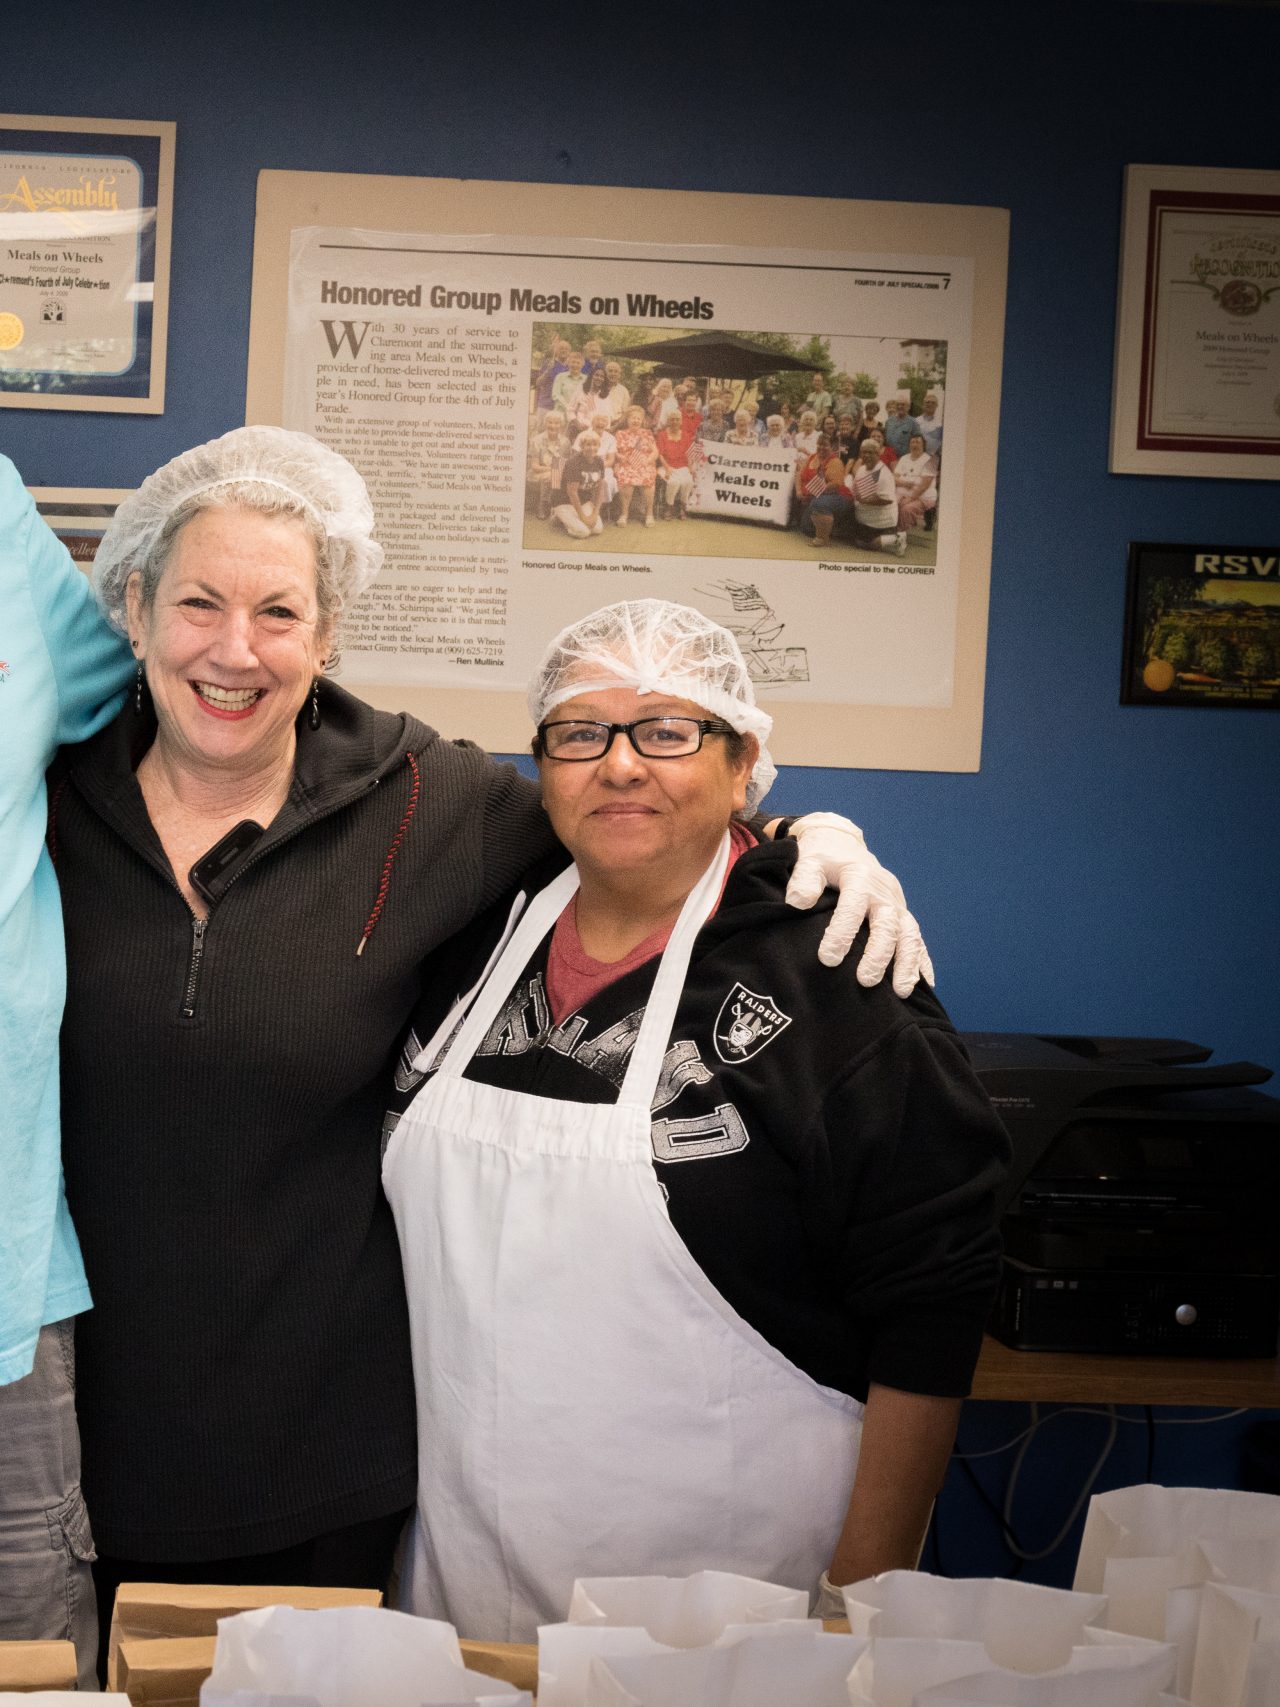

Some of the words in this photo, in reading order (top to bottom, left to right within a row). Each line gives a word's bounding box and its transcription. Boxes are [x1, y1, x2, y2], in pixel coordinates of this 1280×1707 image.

[8, 249, 41, 261] Meals
[63, 252, 103, 263] Wheels
[29, 265, 58, 273] Honored
[60, 265, 80, 275] Group
[36, 276, 53, 288] Fourth
[55, 276, 60, 287] of
[62, 276, 73, 290] July
[942, 278, 950, 290] 7
[321, 280, 421, 308] Honored
[431, 285, 501, 316] Group
[510, 288, 581, 315] Meals
[590, 297, 619, 316] on
[627, 293, 713, 321] Wheels
[392, 323, 405, 334] 30
[412, 327, 439, 338] years
[447, 325, 458, 336] of
[465, 329, 501, 338] service
[509, 330, 519, 338] to
[1196, 330, 1225, 342] Meals
[1228, 331, 1240, 342] on
[1242, 332, 1279, 343] Wheels
[371, 336, 423, 349] Claremont
[428, 338, 446, 349] and
[450, 339, 465, 350] the
[471, 340, 518, 352] surround-
[370, 350, 386, 363] ing
[391, 353, 411, 362] area
[416, 352, 446, 363] Meals
[450, 355, 462, 364] on
[468, 354, 507, 366] Wheels,
[317, 362, 358, 376] provider
[361, 363, 372, 374] of
[374, 364, 450, 377] home-delivered
[452, 367, 481, 378] meals
[483, 370, 493, 378] to
[495, 371, 516, 382] peo-
[316, 375, 332, 388] ple
[338, 376, 347, 387] in
[353, 377, 379, 388] need,
[385, 378, 402, 389] has
[408, 379, 431, 390] been
[437, 380, 476, 392] selected
[483, 384, 492, 392] as
[499, 383, 516, 393] this
[316, 388, 345, 403] year's
[348, 390, 391, 402] Honored
[394, 392, 426, 406] Group
[429, 393, 443, 404] for
[446, 394, 461, 405] the
[464, 394, 479, 405] 4th
[482, 395, 493, 406] of
[495, 396, 516, 409] July
[316, 402, 352, 414] Parade.
[324, 415, 343, 424] With
[358, 418, 394, 426] extensive
[397, 420, 419, 430] group
[478, 421, 501, 431] Meals
[315, 425, 343, 434] Wheels
[381, 428, 410, 439] provide
[412, 428, 472, 440] home-delivered
[474, 433, 505, 441] services
[427, 450, 467, 460] Volunteers
[708, 454, 790, 473] Claremont
[714, 472, 756, 487] Meals
[760, 480, 779, 490] on
[716, 490, 772, 508] Wheels
[417, 502, 450, 511] residents
[463, 503, 477, 512] San
[480, 504, 511, 513] Antonio
[400, 511, 436, 523] packaged
[460, 513, 496, 523] delivered
[428, 522, 467, 532] Deliveries
[376, 530, 400, 541] Friday
[448, 533, 479, 544] holidays
[522, 561, 555, 569] Honored
[558, 562, 582, 572] Group
[585, 563, 607, 571] Meals
[622, 565, 652, 573] Wheels.
[819, 563, 841, 571] Photo
[844, 565, 871, 573] special
[883, 566, 895, 574] the
[898, 564, 935, 575] COURIER
[1195, 554, 1280, 576] RSV
[437, 635, 460, 644] Meals
[477, 637, 505, 646] Wheels
[375, 643, 397, 654] Ginny
[400, 644, 434, 656] Schirripa
[474, 658, 504, 666] Mullinix
[738, 991, 784, 1025] RAIDERS
